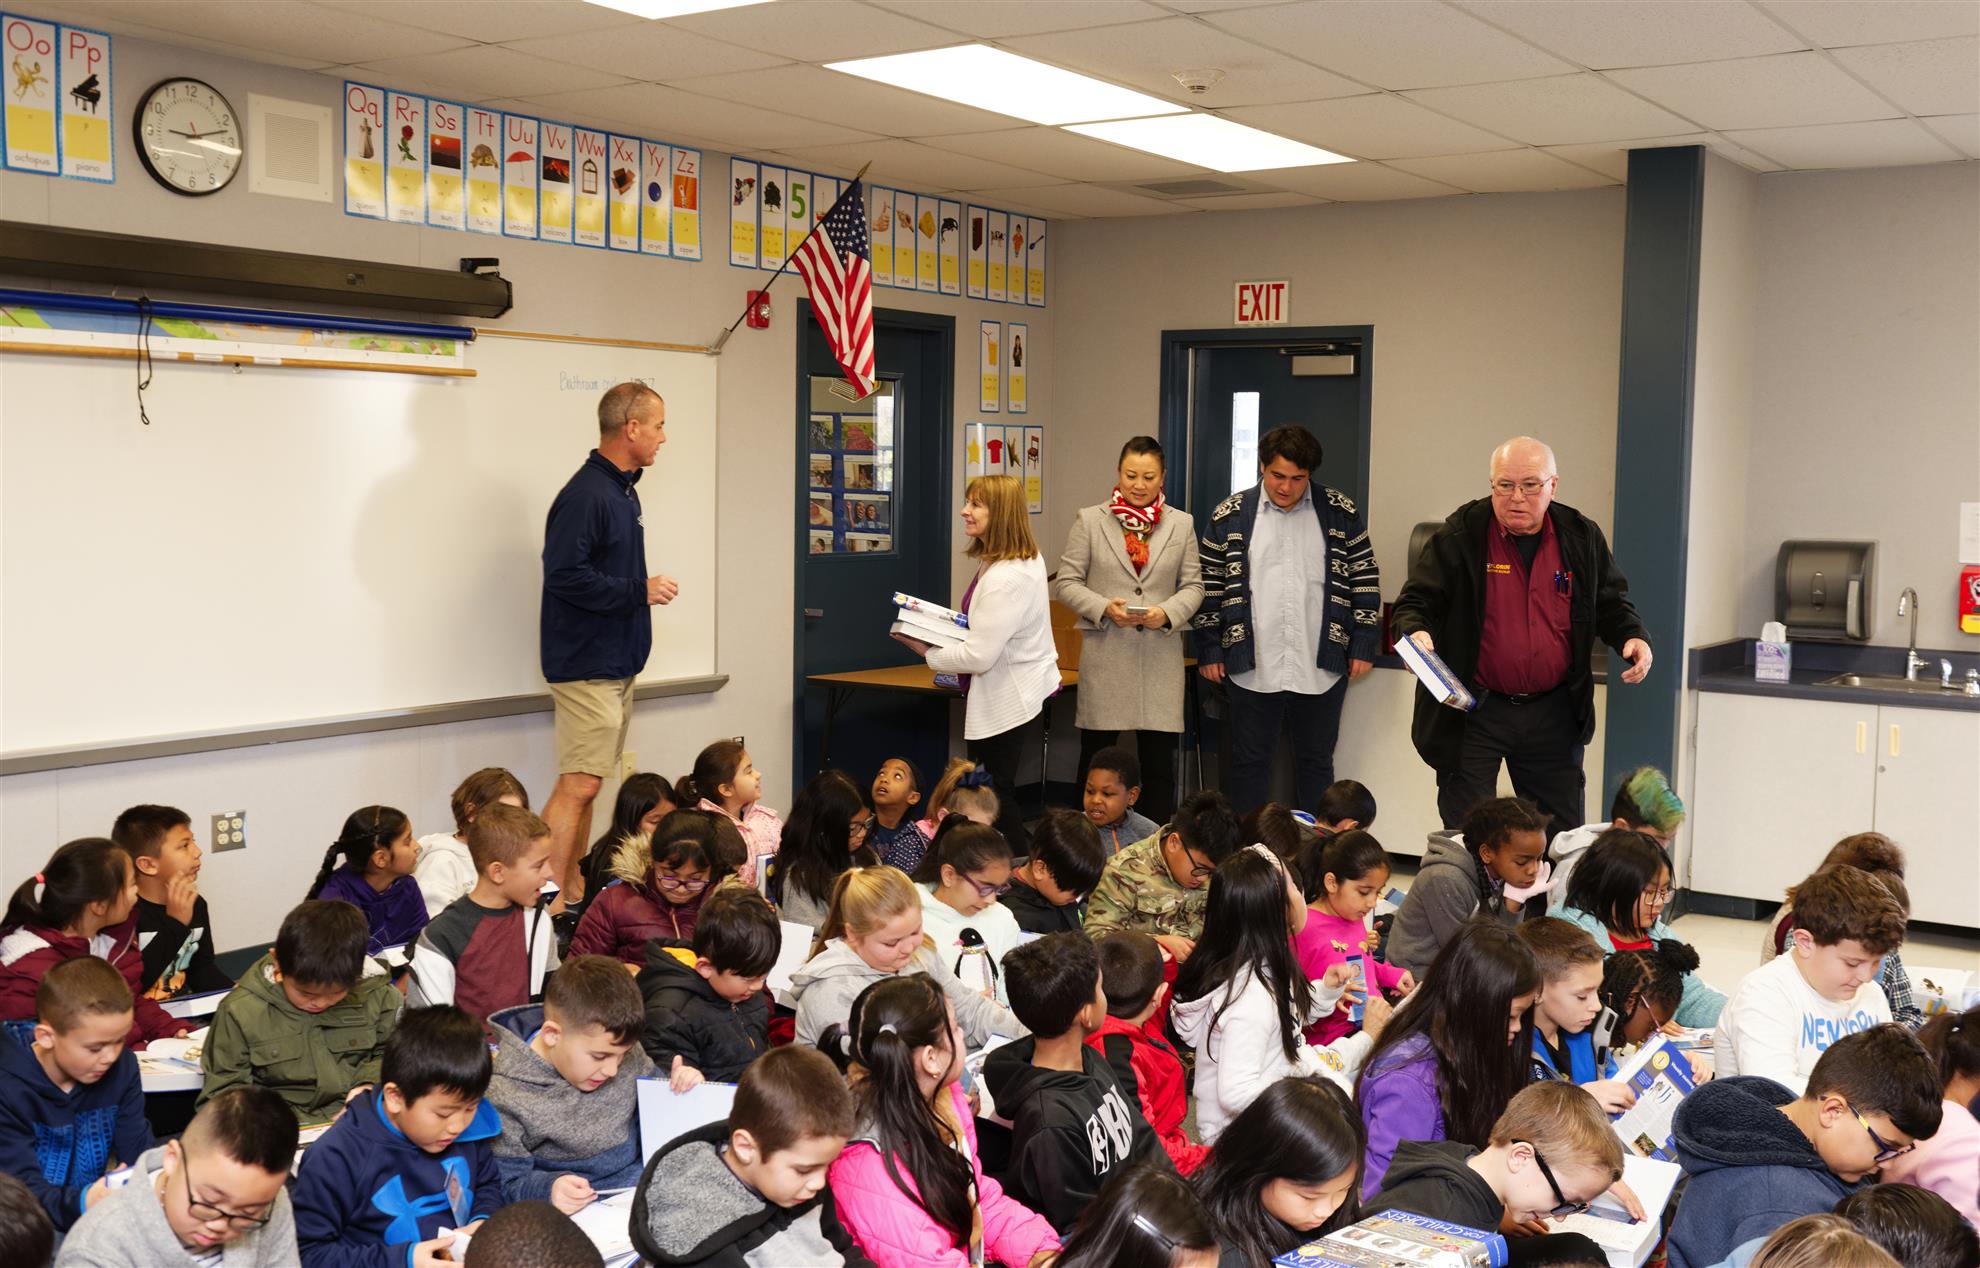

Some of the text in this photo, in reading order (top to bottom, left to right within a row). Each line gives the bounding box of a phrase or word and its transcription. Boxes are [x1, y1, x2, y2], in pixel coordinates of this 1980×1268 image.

[7, 21, 51, 56] Oo
[70, 31, 102, 74] Pp
[165, 87, 176, 98] 11
[185, 85, 198, 98] 12
[209, 95, 215, 107] 1
[222, 114, 230, 126] 2
[348, 87, 382, 128] Qq
[396, 96, 419, 123] Rr
[434, 104, 457, 131] Ss
[474, 111, 495, 137] Tt
[508, 118, 534, 145] Uu
[228, 137, 235, 148] 3
[546, 125, 567, 150] Vv
[575, 131, 605, 158] Ww
[613, 139, 634, 163] Xx
[647, 144, 664, 177] Yy
[677, 150, 695, 174] Zz
[168, 167, 176, 179] 7
[189, 176, 196, 188] 6
[209, 173, 216, 185] 5
[791, 182, 806, 219] 5
[1238, 283, 1285, 321] EXIT
[1379, 1210, 1464, 1235] CHILDREN
